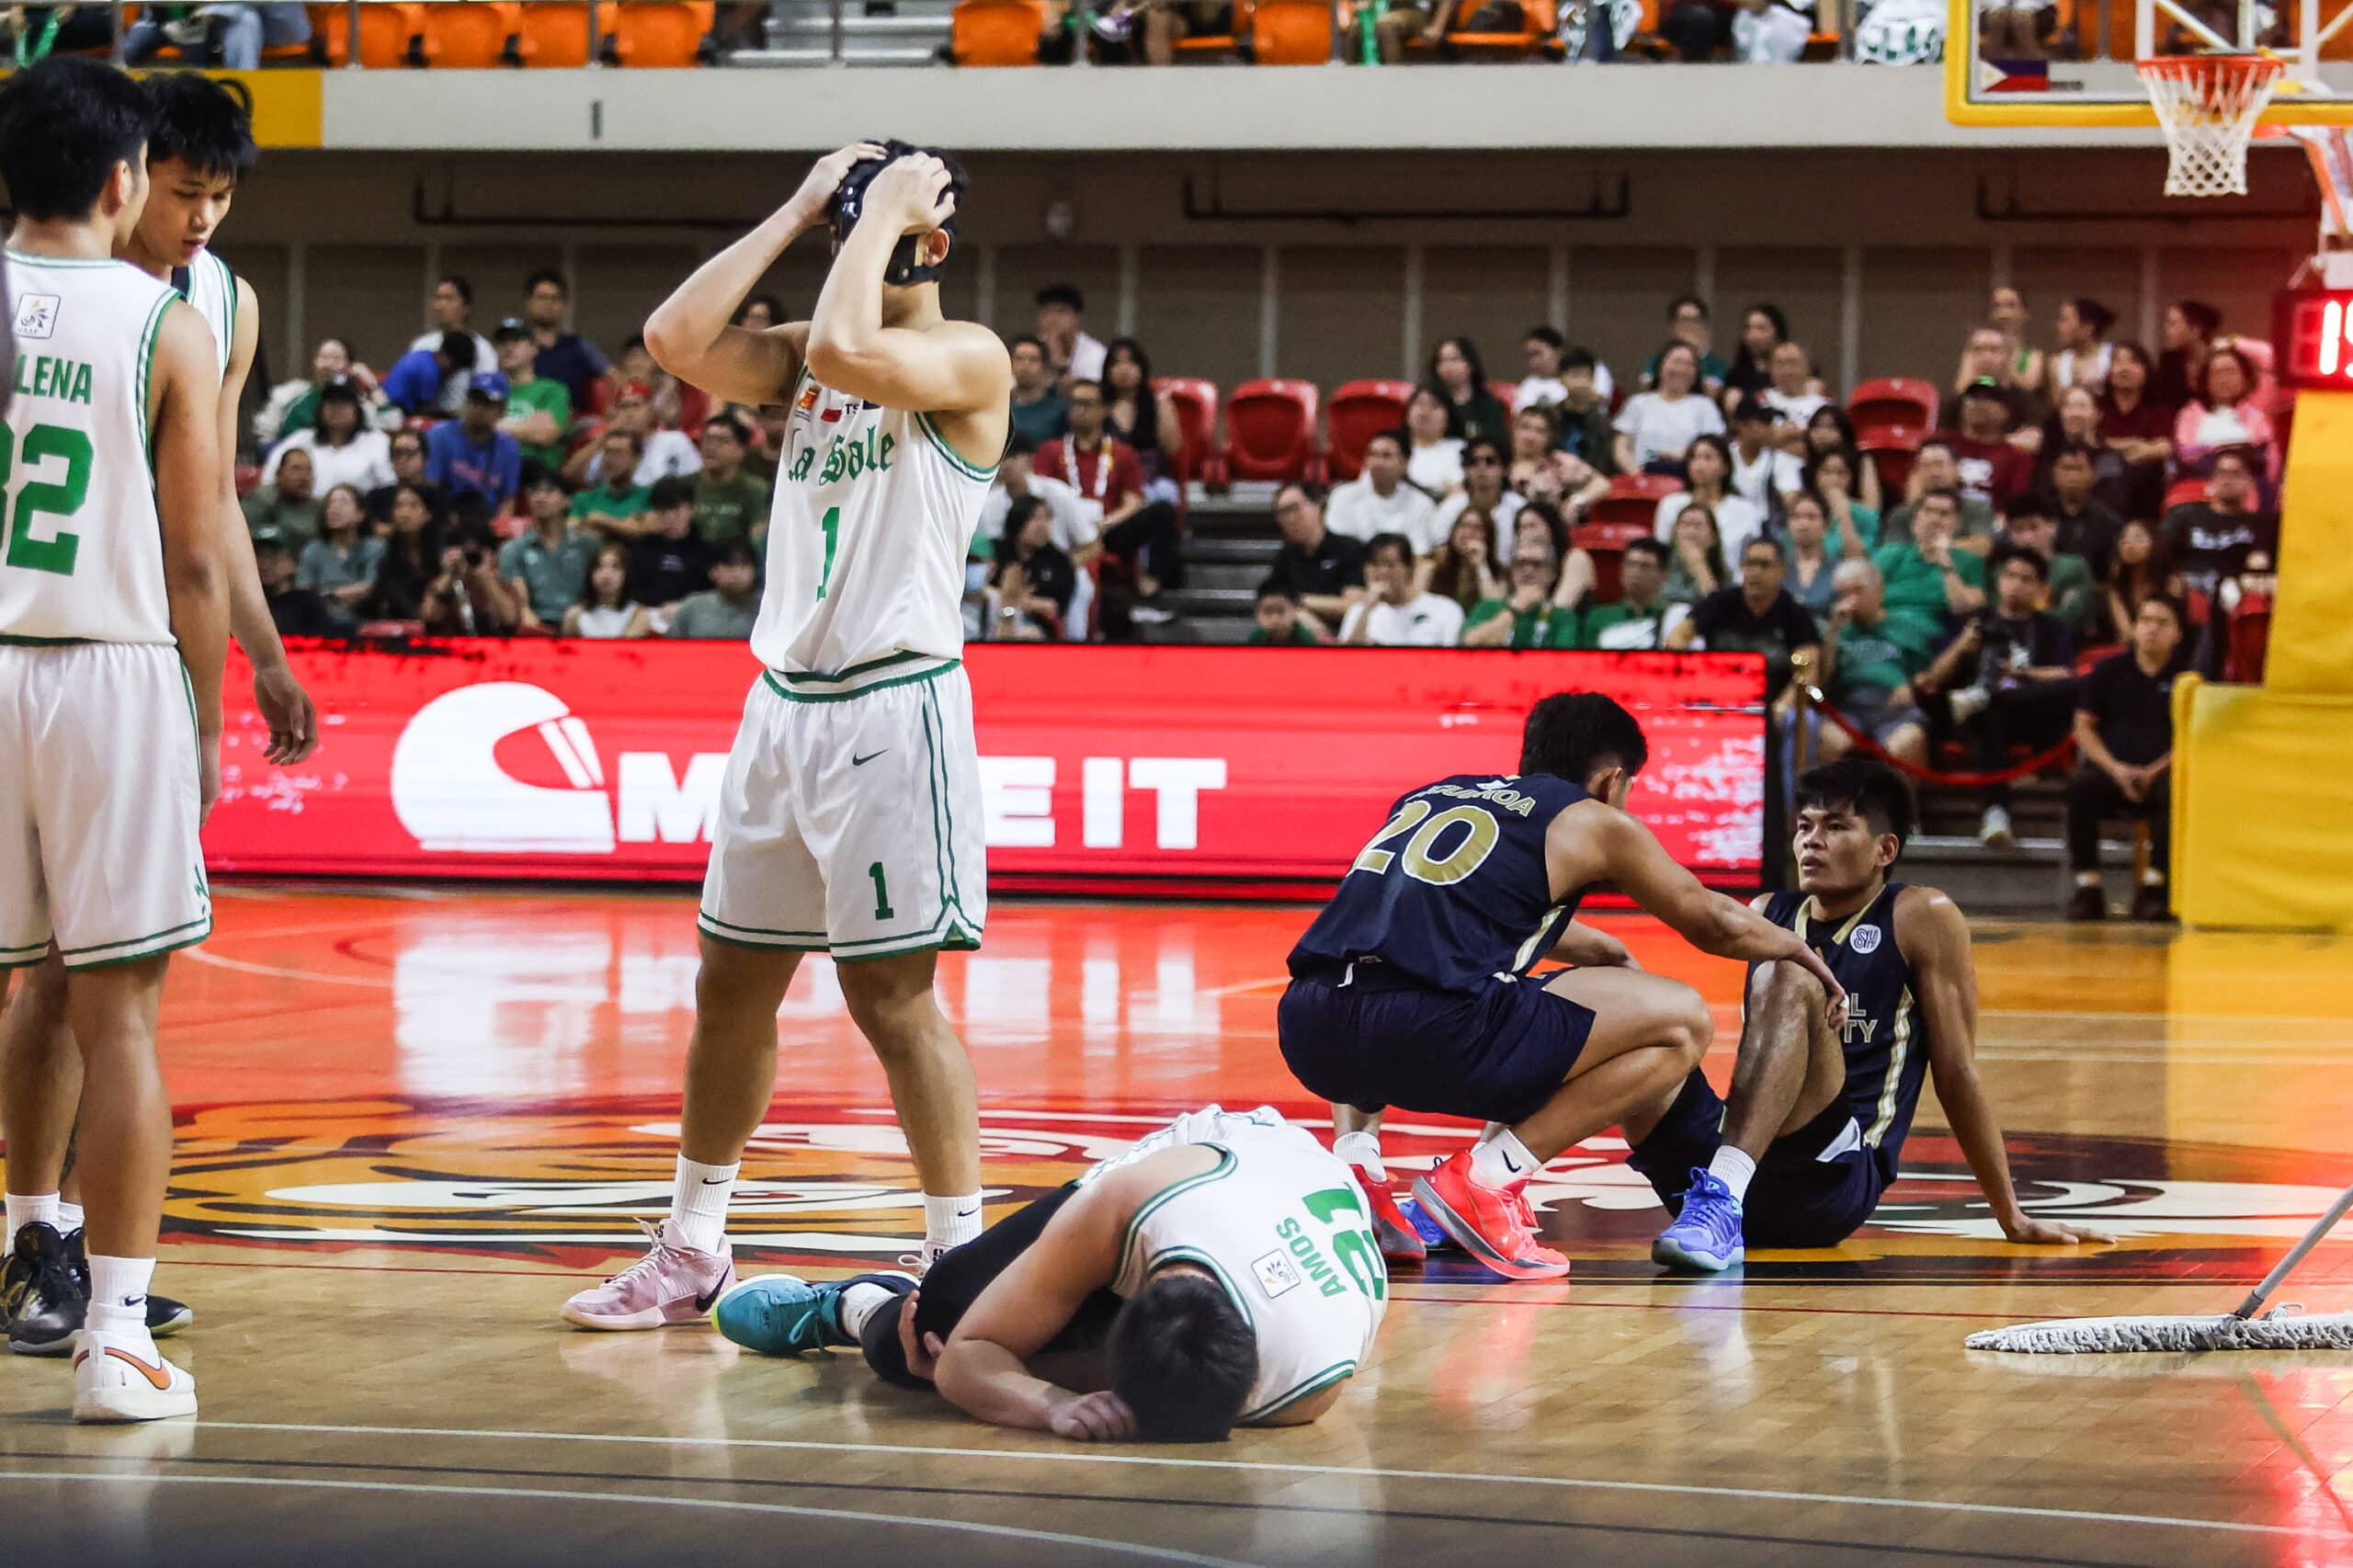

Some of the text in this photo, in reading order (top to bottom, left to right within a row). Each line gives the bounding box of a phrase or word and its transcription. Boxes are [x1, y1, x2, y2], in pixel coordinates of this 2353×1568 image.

[16, 354, 93, 405] LENA
[2319, 300, 2353, 379] 1
[816, 506, 840, 603] 1
[618, 752, 1226, 849] ME IT
[1345, 800, 1500, 886] 20
[869, 861, 894, 920] 1
[1276, 1217, 1348, 1298] AMOS
